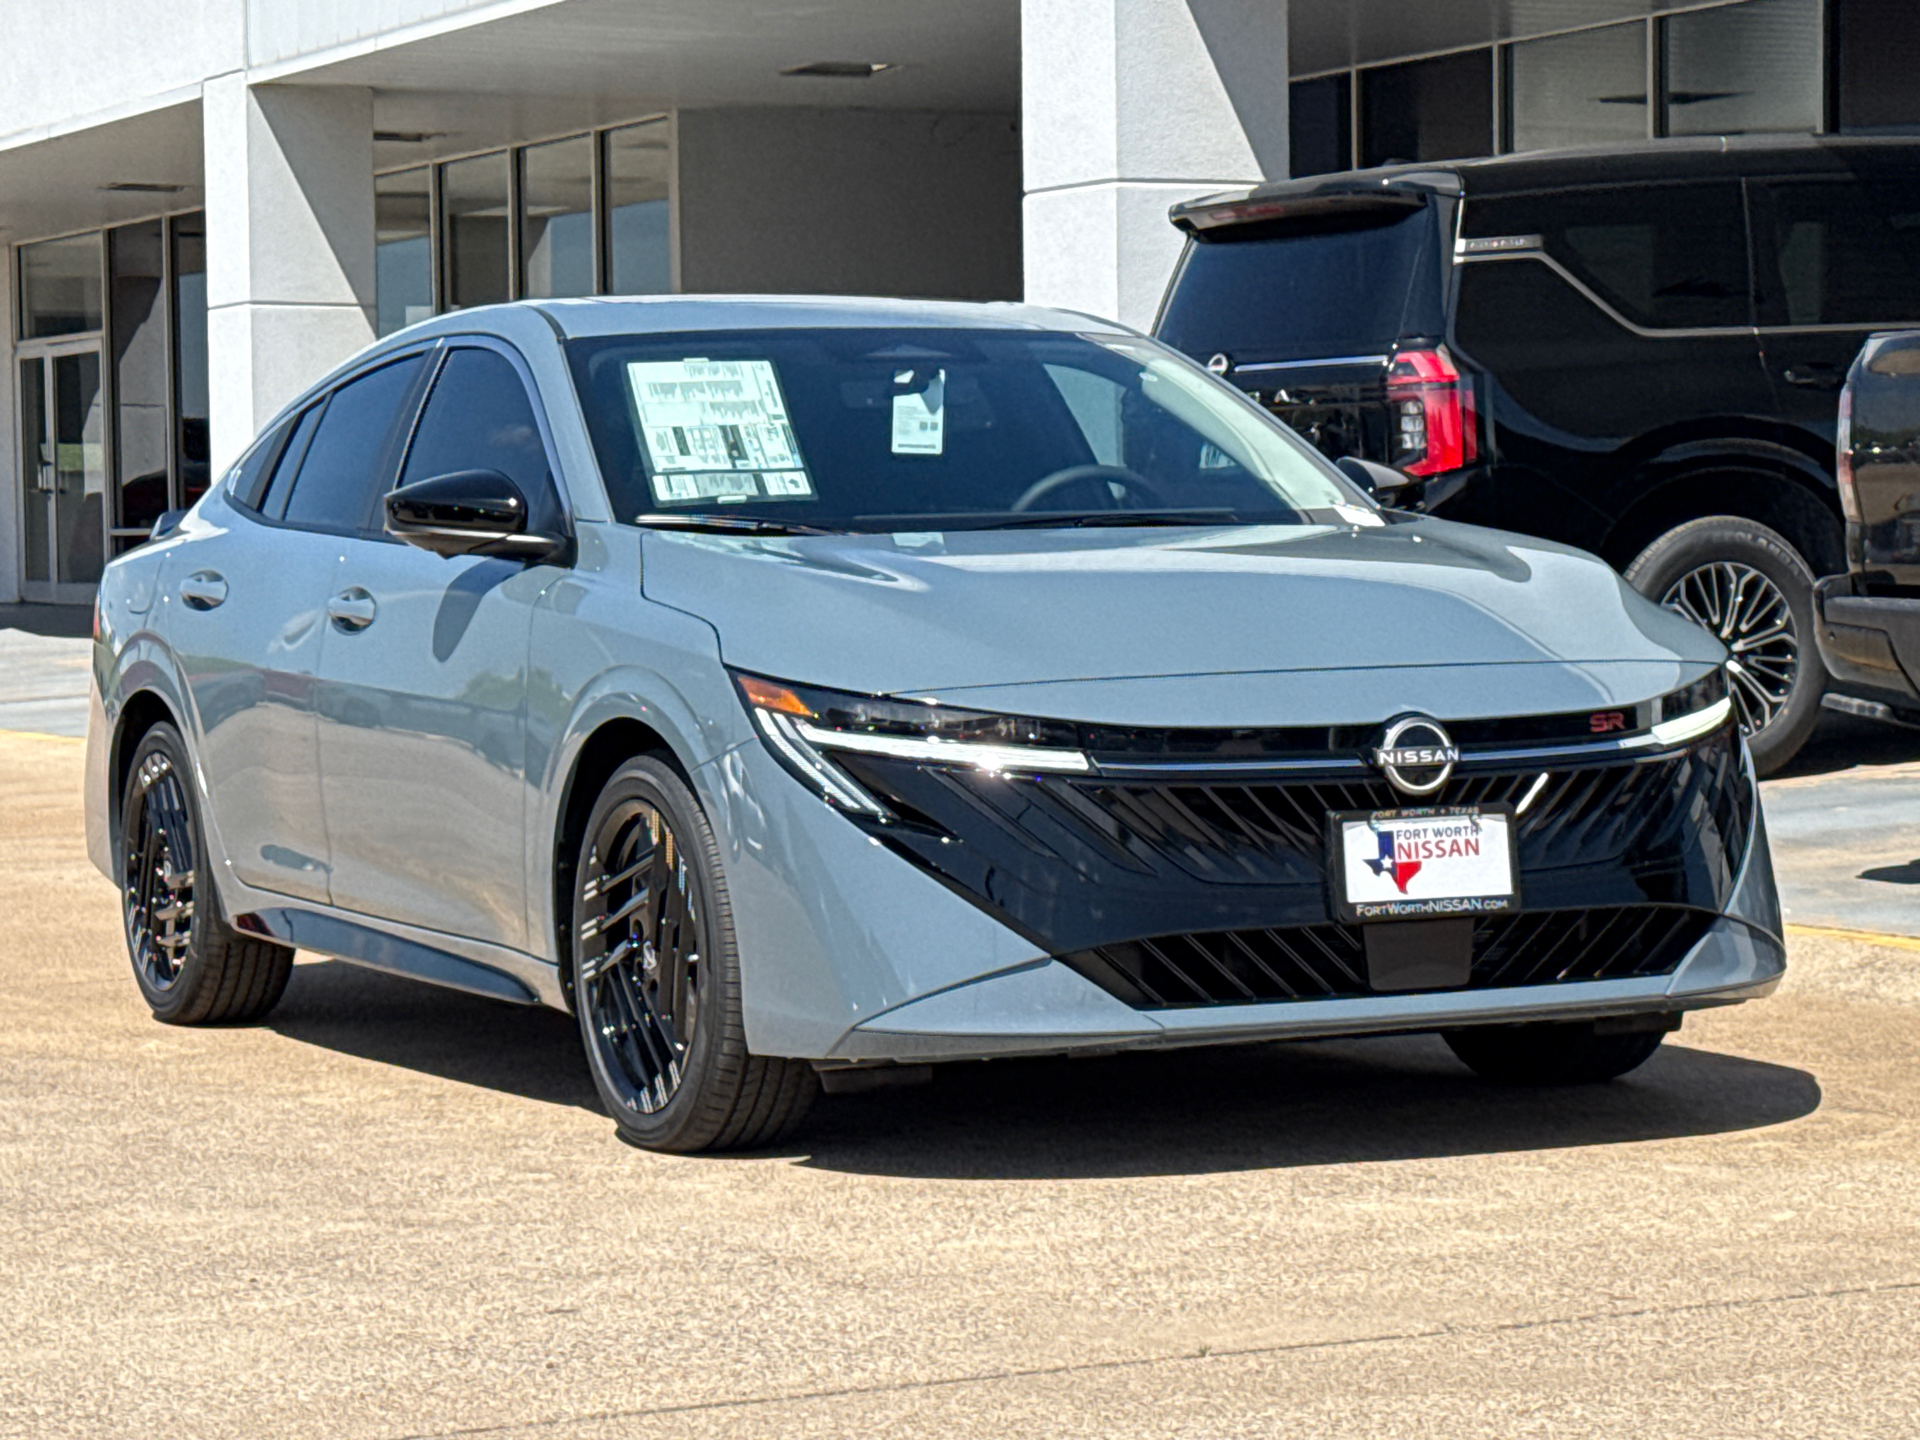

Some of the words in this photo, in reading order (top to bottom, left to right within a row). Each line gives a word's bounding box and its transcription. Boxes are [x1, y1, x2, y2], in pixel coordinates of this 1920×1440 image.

[1589, 711, 1626, 733] SR
[1379, 748, 1459, 764] NISSAN
[1371, 809, 1397, 819] FORT
[1401, 807, 1436, 817] WORTH
[1449, 805, 1479, 815] TEXAS
[1396, 828, 1428, 840] FORT
[1432, 825, 1479, 839] WORTH
[1397, 838, 1480, 860] NISSAN
